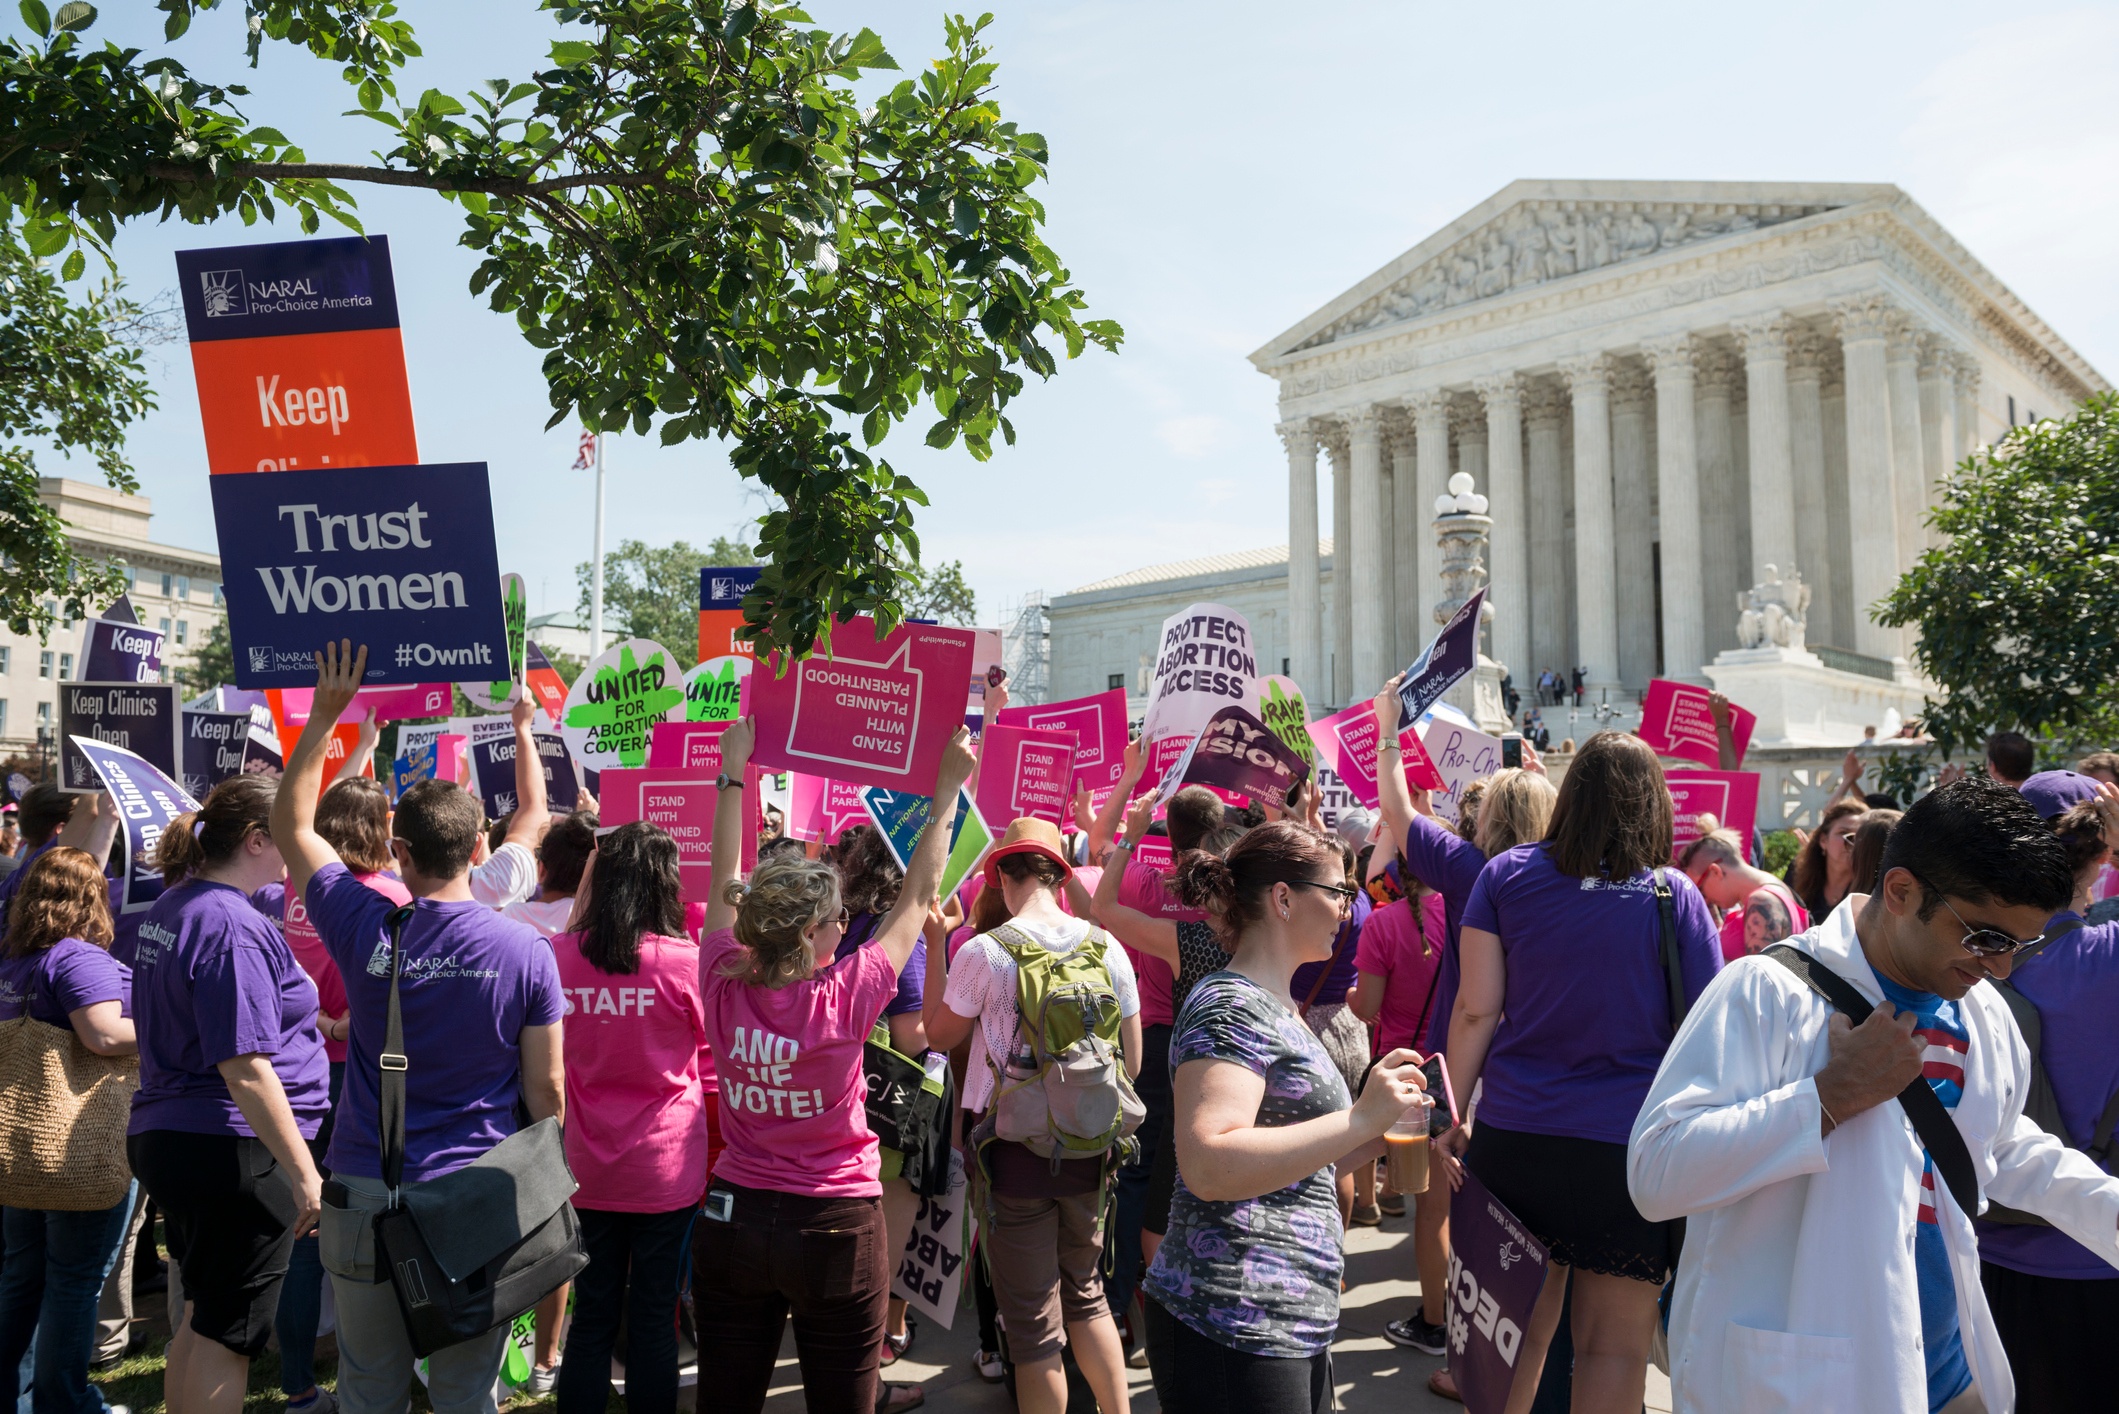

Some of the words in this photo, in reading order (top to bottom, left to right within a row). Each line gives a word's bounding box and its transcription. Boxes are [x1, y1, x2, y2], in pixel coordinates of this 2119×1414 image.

[248, 277, 317, 299] NARAL
[251, 298, 318, 314] Pro-Choice
[321, 294, 373, 309] America
[256, 373, 350, 436] Keep
[278, 501, 432, 553] Trust
[255, 564, 469, 615] Women
[111, 628, 152, 660] Keep
[919, 635, 967, 648] #StandwithPP
[1164, 616, 1246, 651] PROTECT
[275, 651, 314, 663] NARAL
[395, 642, 492, 668] #OwnIt
[1155, 643, 1256, 681] ABORTION
[1426, 641, 1447, 671] pen
[587, 664, 666, 705] UNITED
[686, 680, 741, 705] UNITE
[805, 668, 910, 697] PARENTHOOD
[1158, 670, 1244, 702] ACCESS
[1418, 671, 1446, 698] NARAL
[71, 689, 103, 720] Keep
[108, 689, 157, 717] Clinics
[615, 699, 646, 718] FOR
[700, 705, 730, 719] FOR
[836, 692, 908, 716] PLANNED
[1676, 707, 1700, 719] WITH
[1677, 699, 1708, 712] STAND
[190, 715, 229, 752] Keep
[866, 717, 905, 736] WITH
[1344, 722, 1376, 743] STAND
[1672, 724, 1720, 743] PARENTHO
[1674, 716, 1716, 731] PLANNED
[326, 736, 345, 760] en
[488, 741, 516, 763] Kee
[584, 733, 653, 754] COVERA
[691, 745, 722, 755] STAN
[852, 734, 903, 755] STAND
[1161, 738, 1194, 750] PLANN
[1350, 737, 1374, 752] WITH
[216, 746, 241, 773] Open
[691, 757, 719, 767] WITH
[1024, 753, 1054, 765] STAND
[1357, 748, 1378, 764] PLAN
[1024, 766, 1047, 778] WITH
[102, 759, 153, 820] Clinics
[832, 784, 860, 795] PLAN
[1021, 779, 1059, 793] PLANNED
[648, 796, 686, 807] STAND
[919, 803, 930, 817] OF
[648, 811, 678, 822] WITH
[889, 798, 923, 839] NATIONAL
[662, 826, 701, 837] ANNED
[906, 823, 927, 851] JEWIS
[1143, 855, 1171, 865] STAND
[1161, 903, 1180, 912] Act.
[404, 968, 457, 980] Pro-Choice
[458, 967, 498, 979] America
[405, 955, 460, 972] NARAL
[563, 987, 656, 1017] STAFF
[729, 1026, 800, 1066] AND
[723, 1077, 825, 1119] VOTE!
[1526, 1241, 1543, 1266] WHOLE
